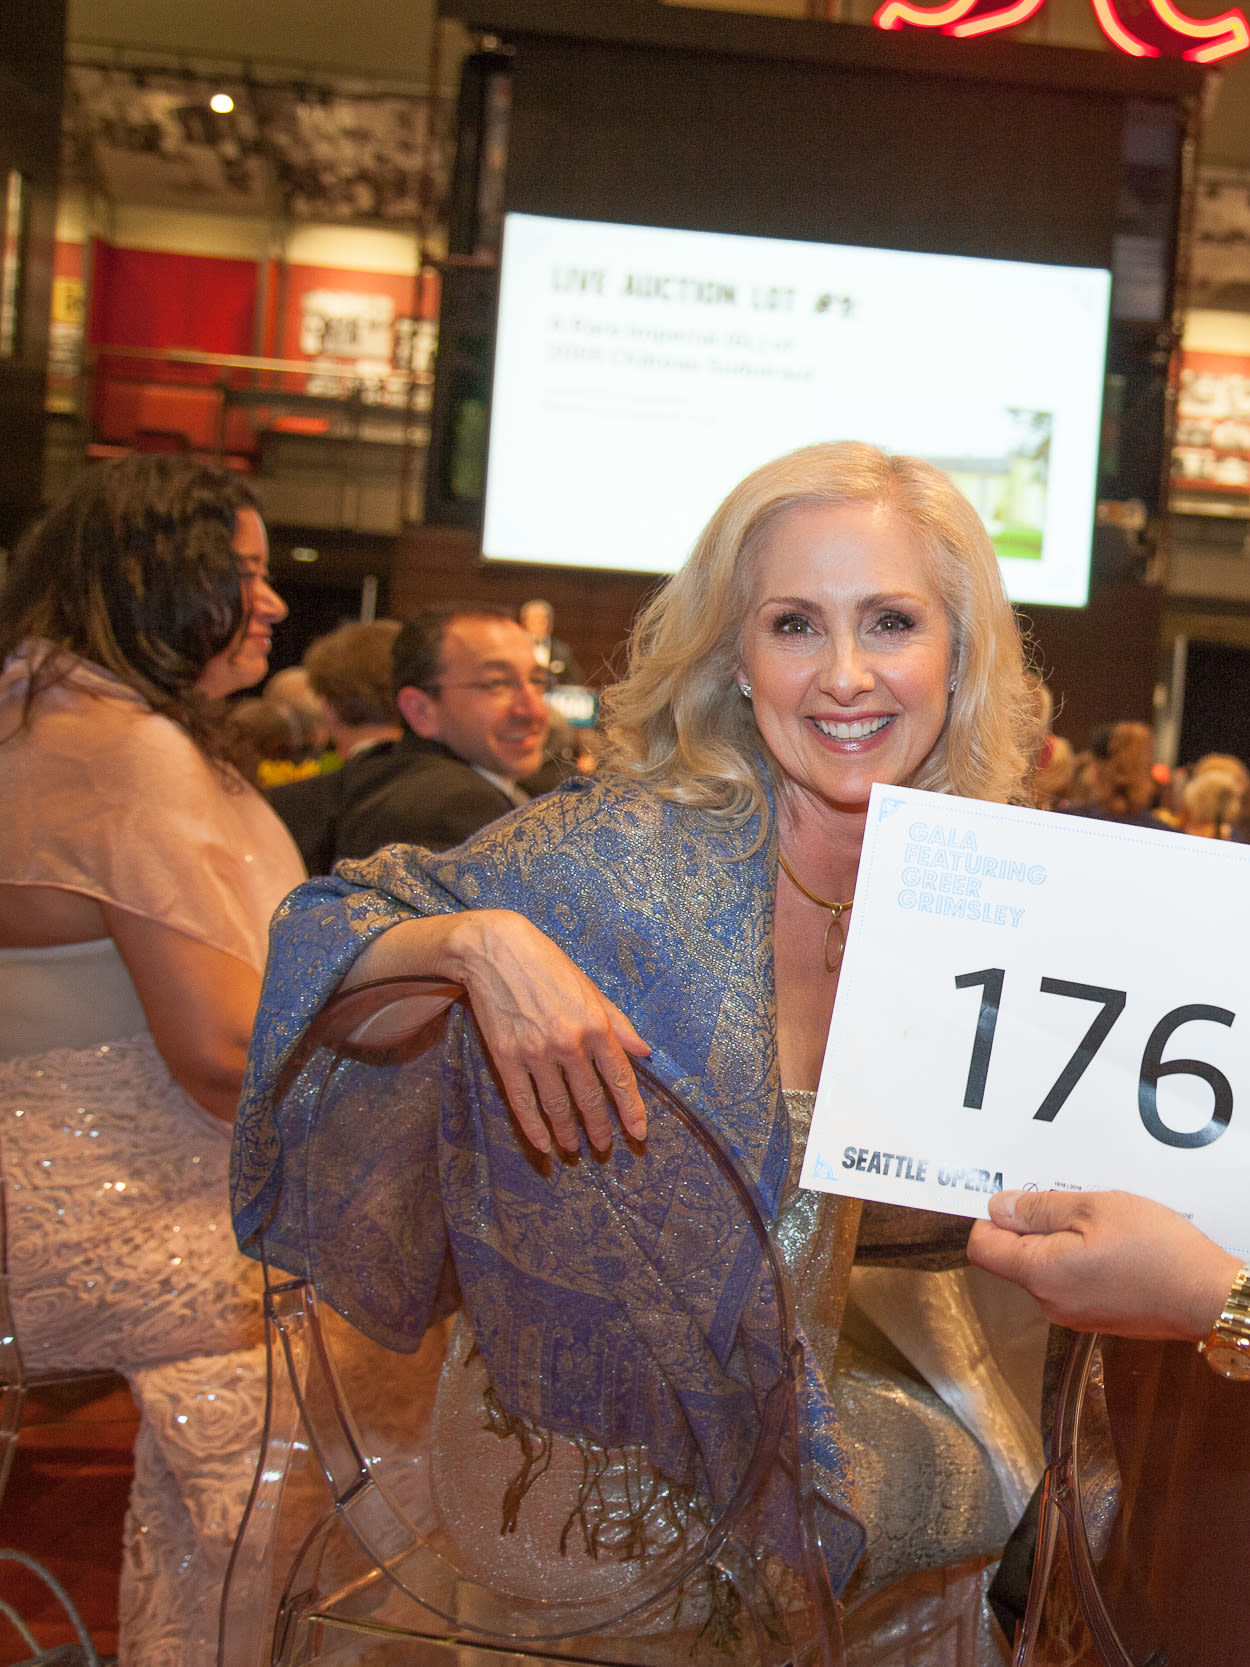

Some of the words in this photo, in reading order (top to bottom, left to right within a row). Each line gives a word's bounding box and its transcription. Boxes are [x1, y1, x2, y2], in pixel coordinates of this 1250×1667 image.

[551, 265, 605, 294] LIVE
[623, 272, 736, 305] AUCTION
[751, 284, 797, 313] LOT
[908, 821, 978, 852] GALA
[900, 866, 983, 898] GREER
[903, 842, 1048, 886] FEATURING
[897, 888, 1027, 929] GRIMSLEY
[954, 967, 1237, 1149] 176
[841, 1146, 929, 1182] SEATTLE
[936, 1160, 1004, 1194] OPERA
